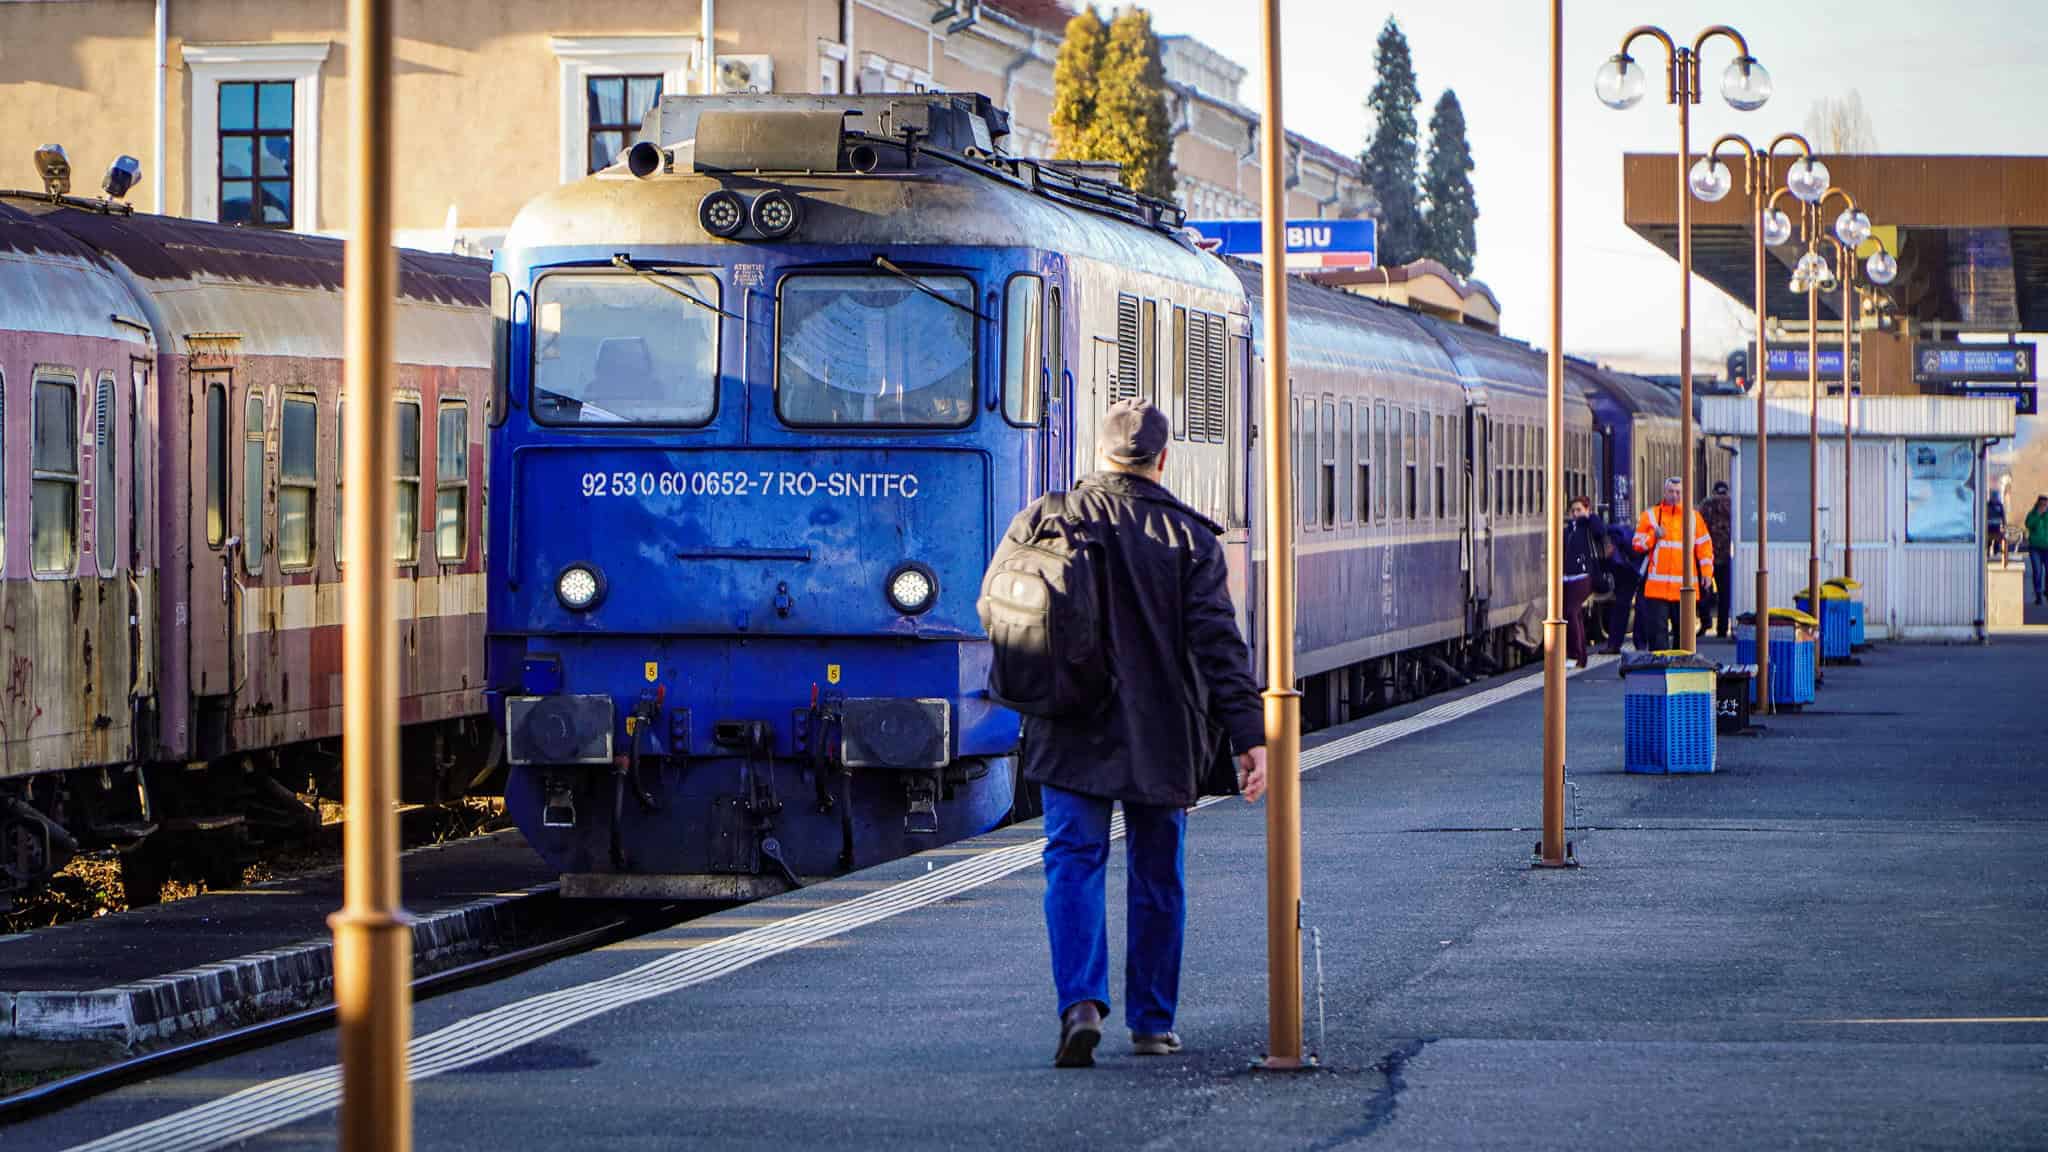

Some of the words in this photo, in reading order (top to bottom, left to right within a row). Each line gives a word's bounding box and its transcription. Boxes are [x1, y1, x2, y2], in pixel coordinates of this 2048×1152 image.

[2015, 350, 2027, 370] 3
[582, 472, 607, 497] 92
[611, 472, 637, 497] 53
[640, 472, 655, 497] 0
[659, 472, 687, 497] 60
[691, 471, 774, 497] 0652-7
[779, 472, 919, 498] RO-SNTFC
